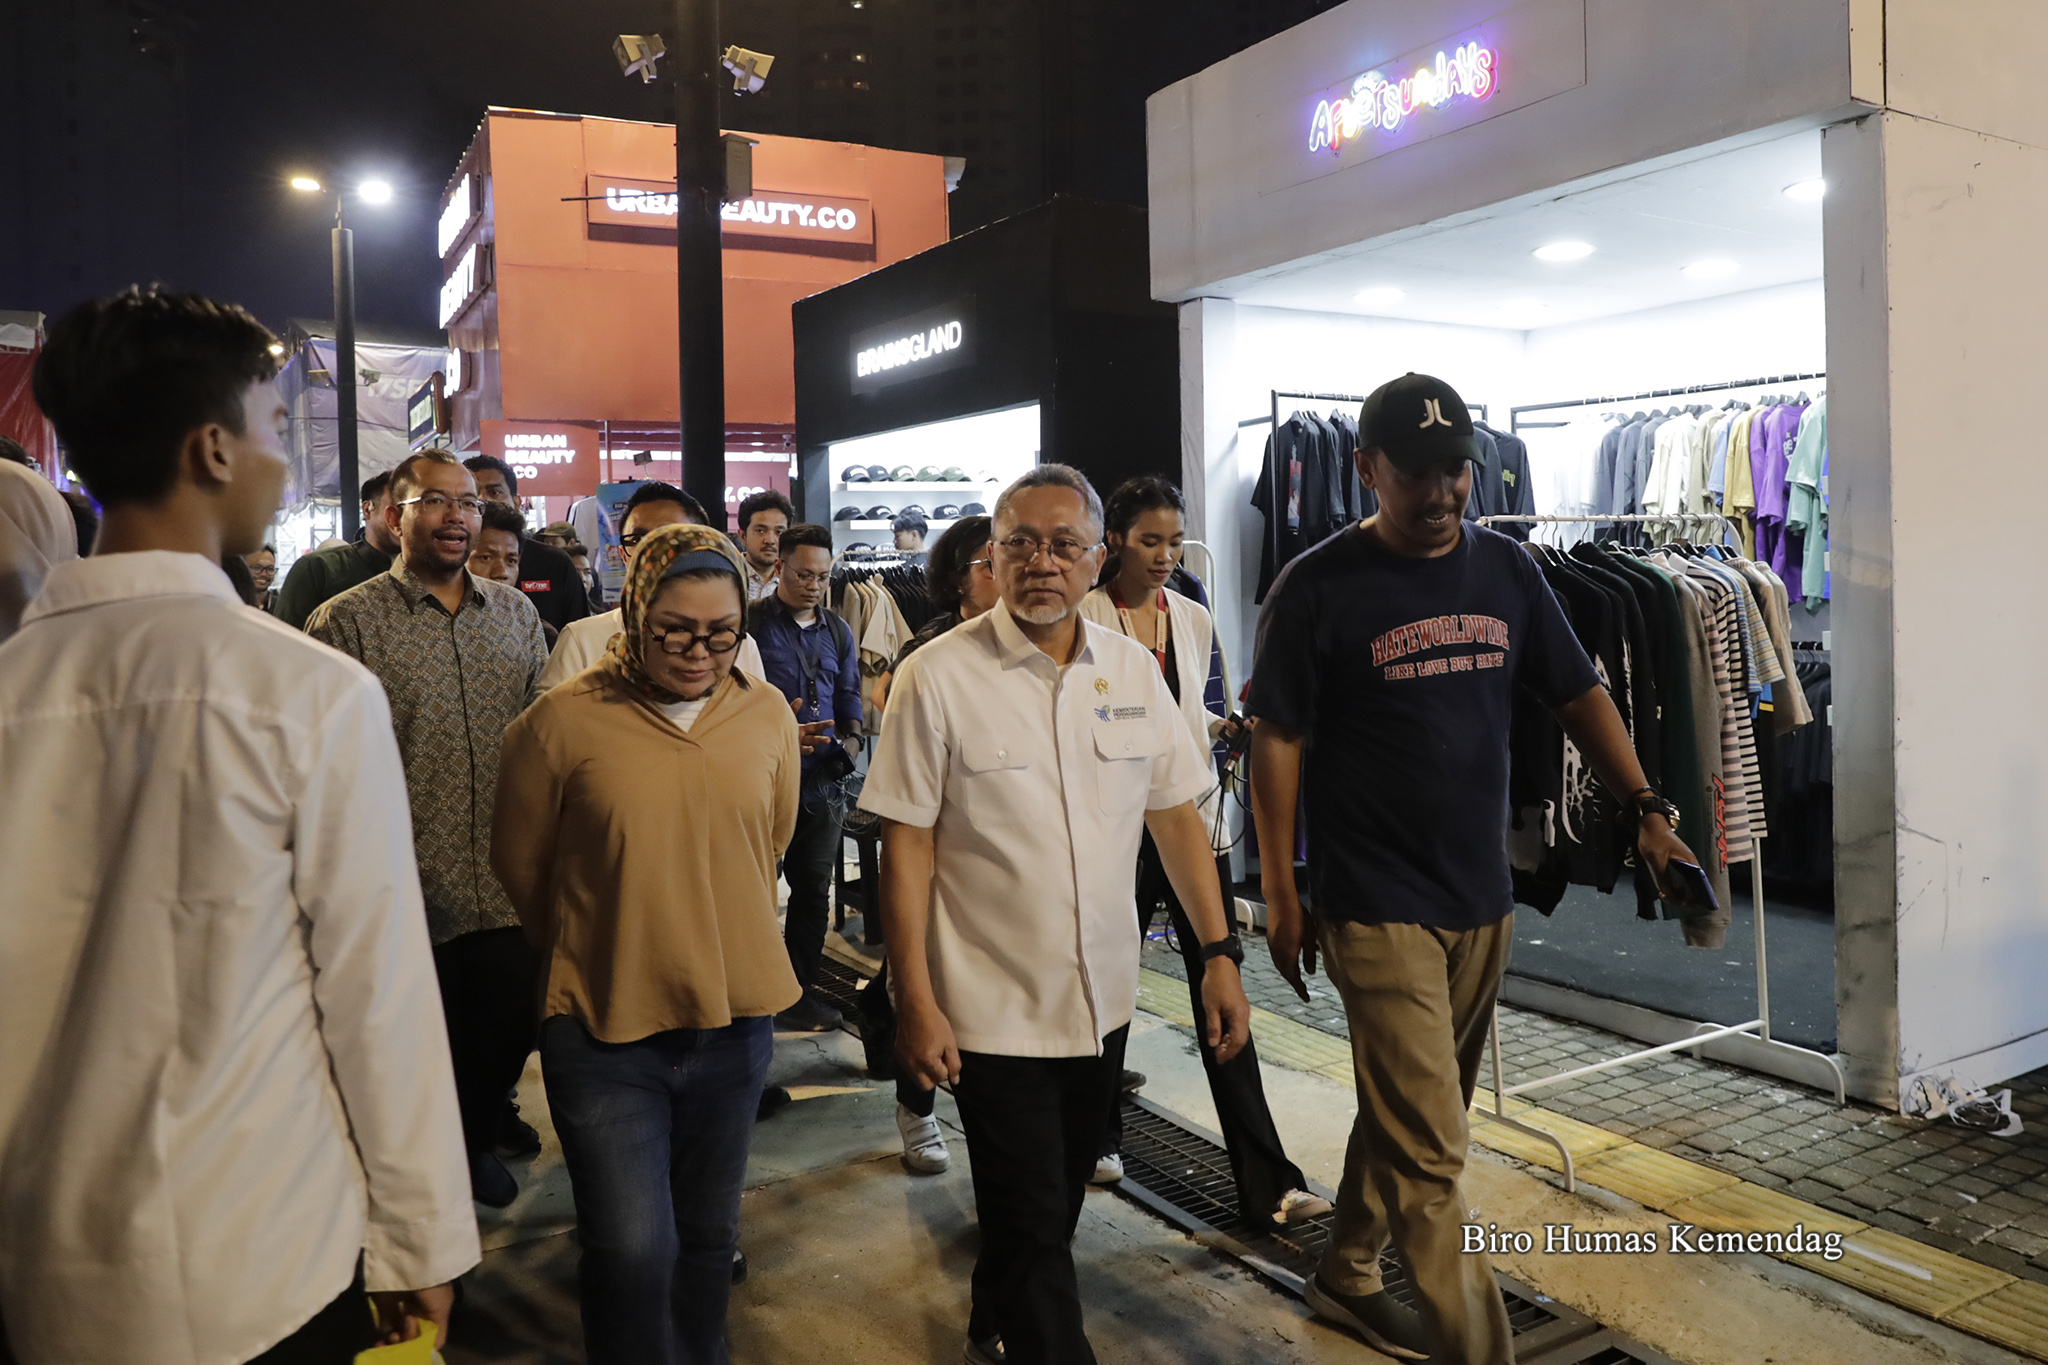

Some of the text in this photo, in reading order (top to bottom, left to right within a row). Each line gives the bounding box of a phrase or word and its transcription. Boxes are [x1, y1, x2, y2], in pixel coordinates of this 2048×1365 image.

[606, 187, 857, 231] URBA EAUTY.CO
[504, 434, 568, 448] URBAN
[505, 449, 576, 465] BEAUTY
[1370, 614, 1510, 667] HATEWORLDWIDE
[1384, 652, 1505, 681] LIKE LOVE BUT HATE
